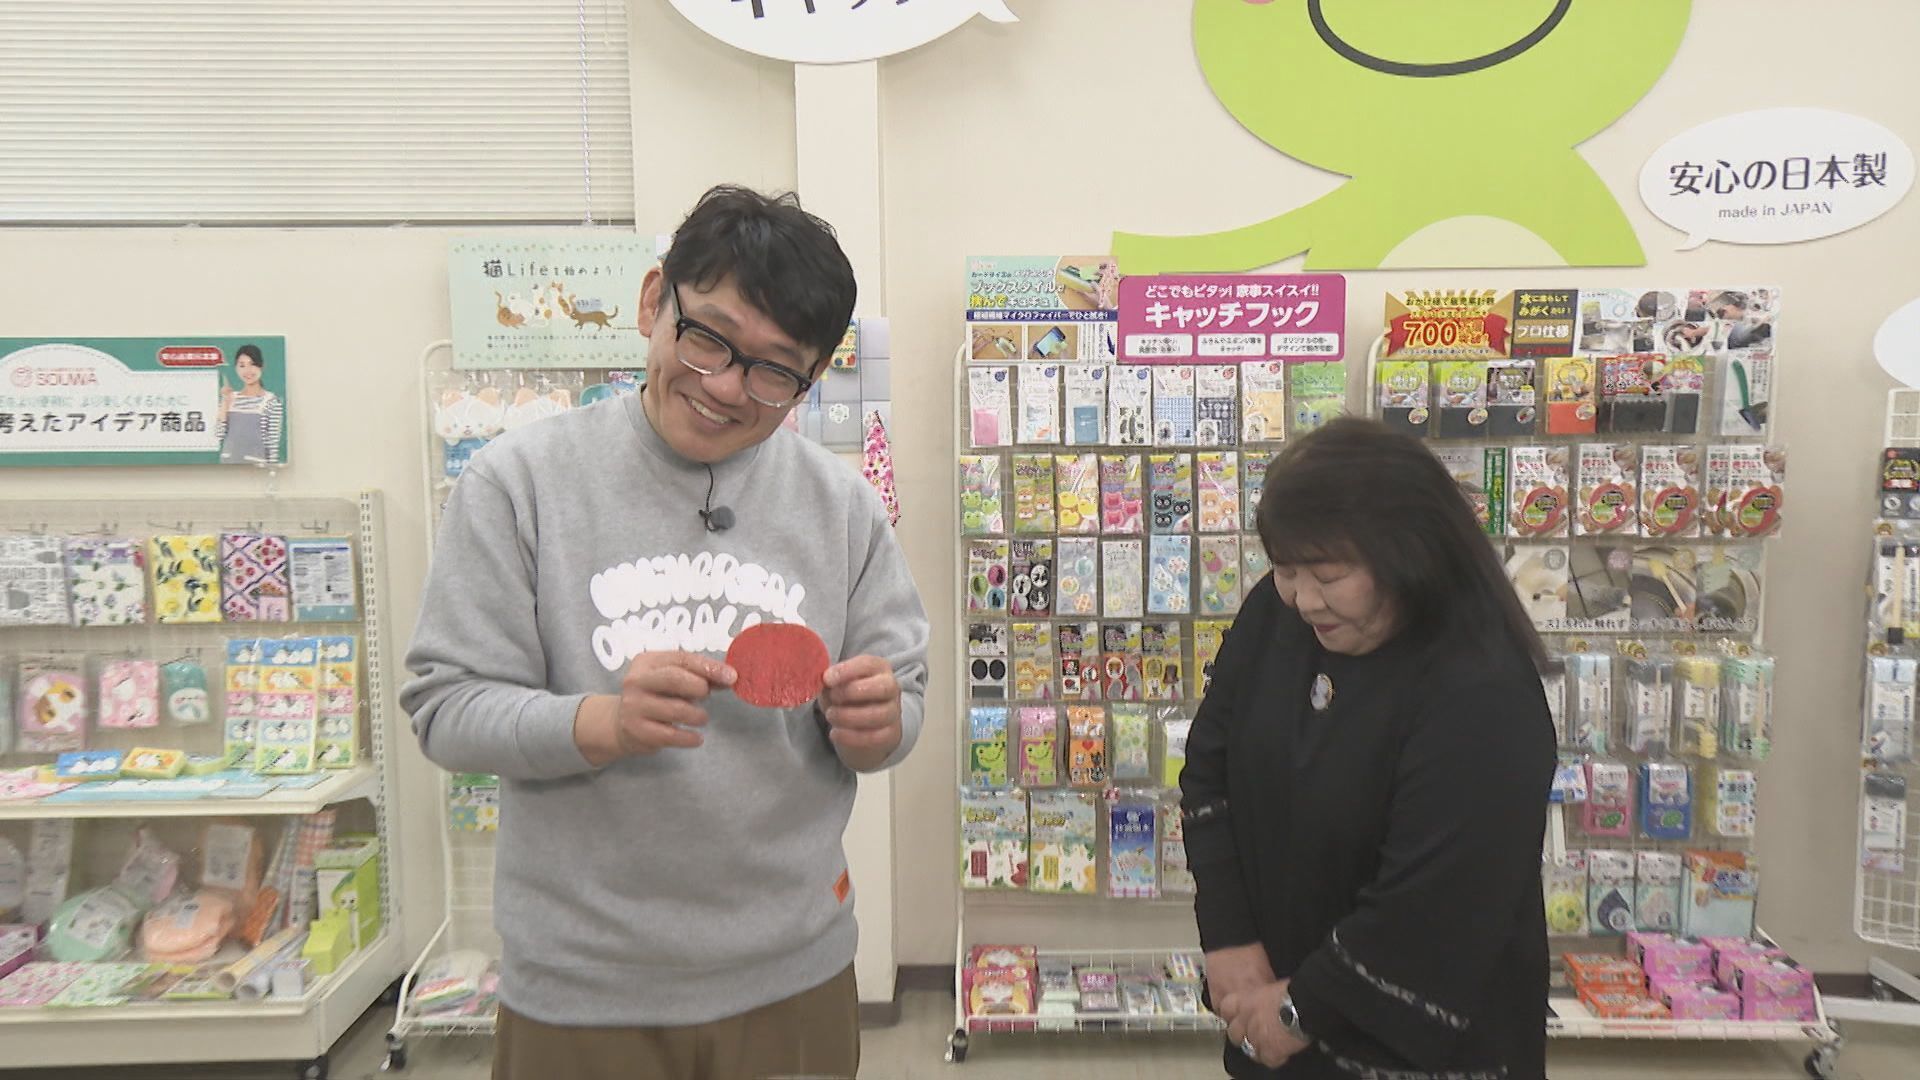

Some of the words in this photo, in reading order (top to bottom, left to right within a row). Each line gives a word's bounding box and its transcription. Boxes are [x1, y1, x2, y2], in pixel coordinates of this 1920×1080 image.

[1669, 152, 1888, 196] 安心の日本製
[1718, 207, 1757, 219] made
[1762, 204, 1776, 216] in
[1780, 202, 1833, 216] JAPAN
[1145, 301, 1320, 328] キャッチフック
[1518, 324, 1570, 339] プロ仕様
